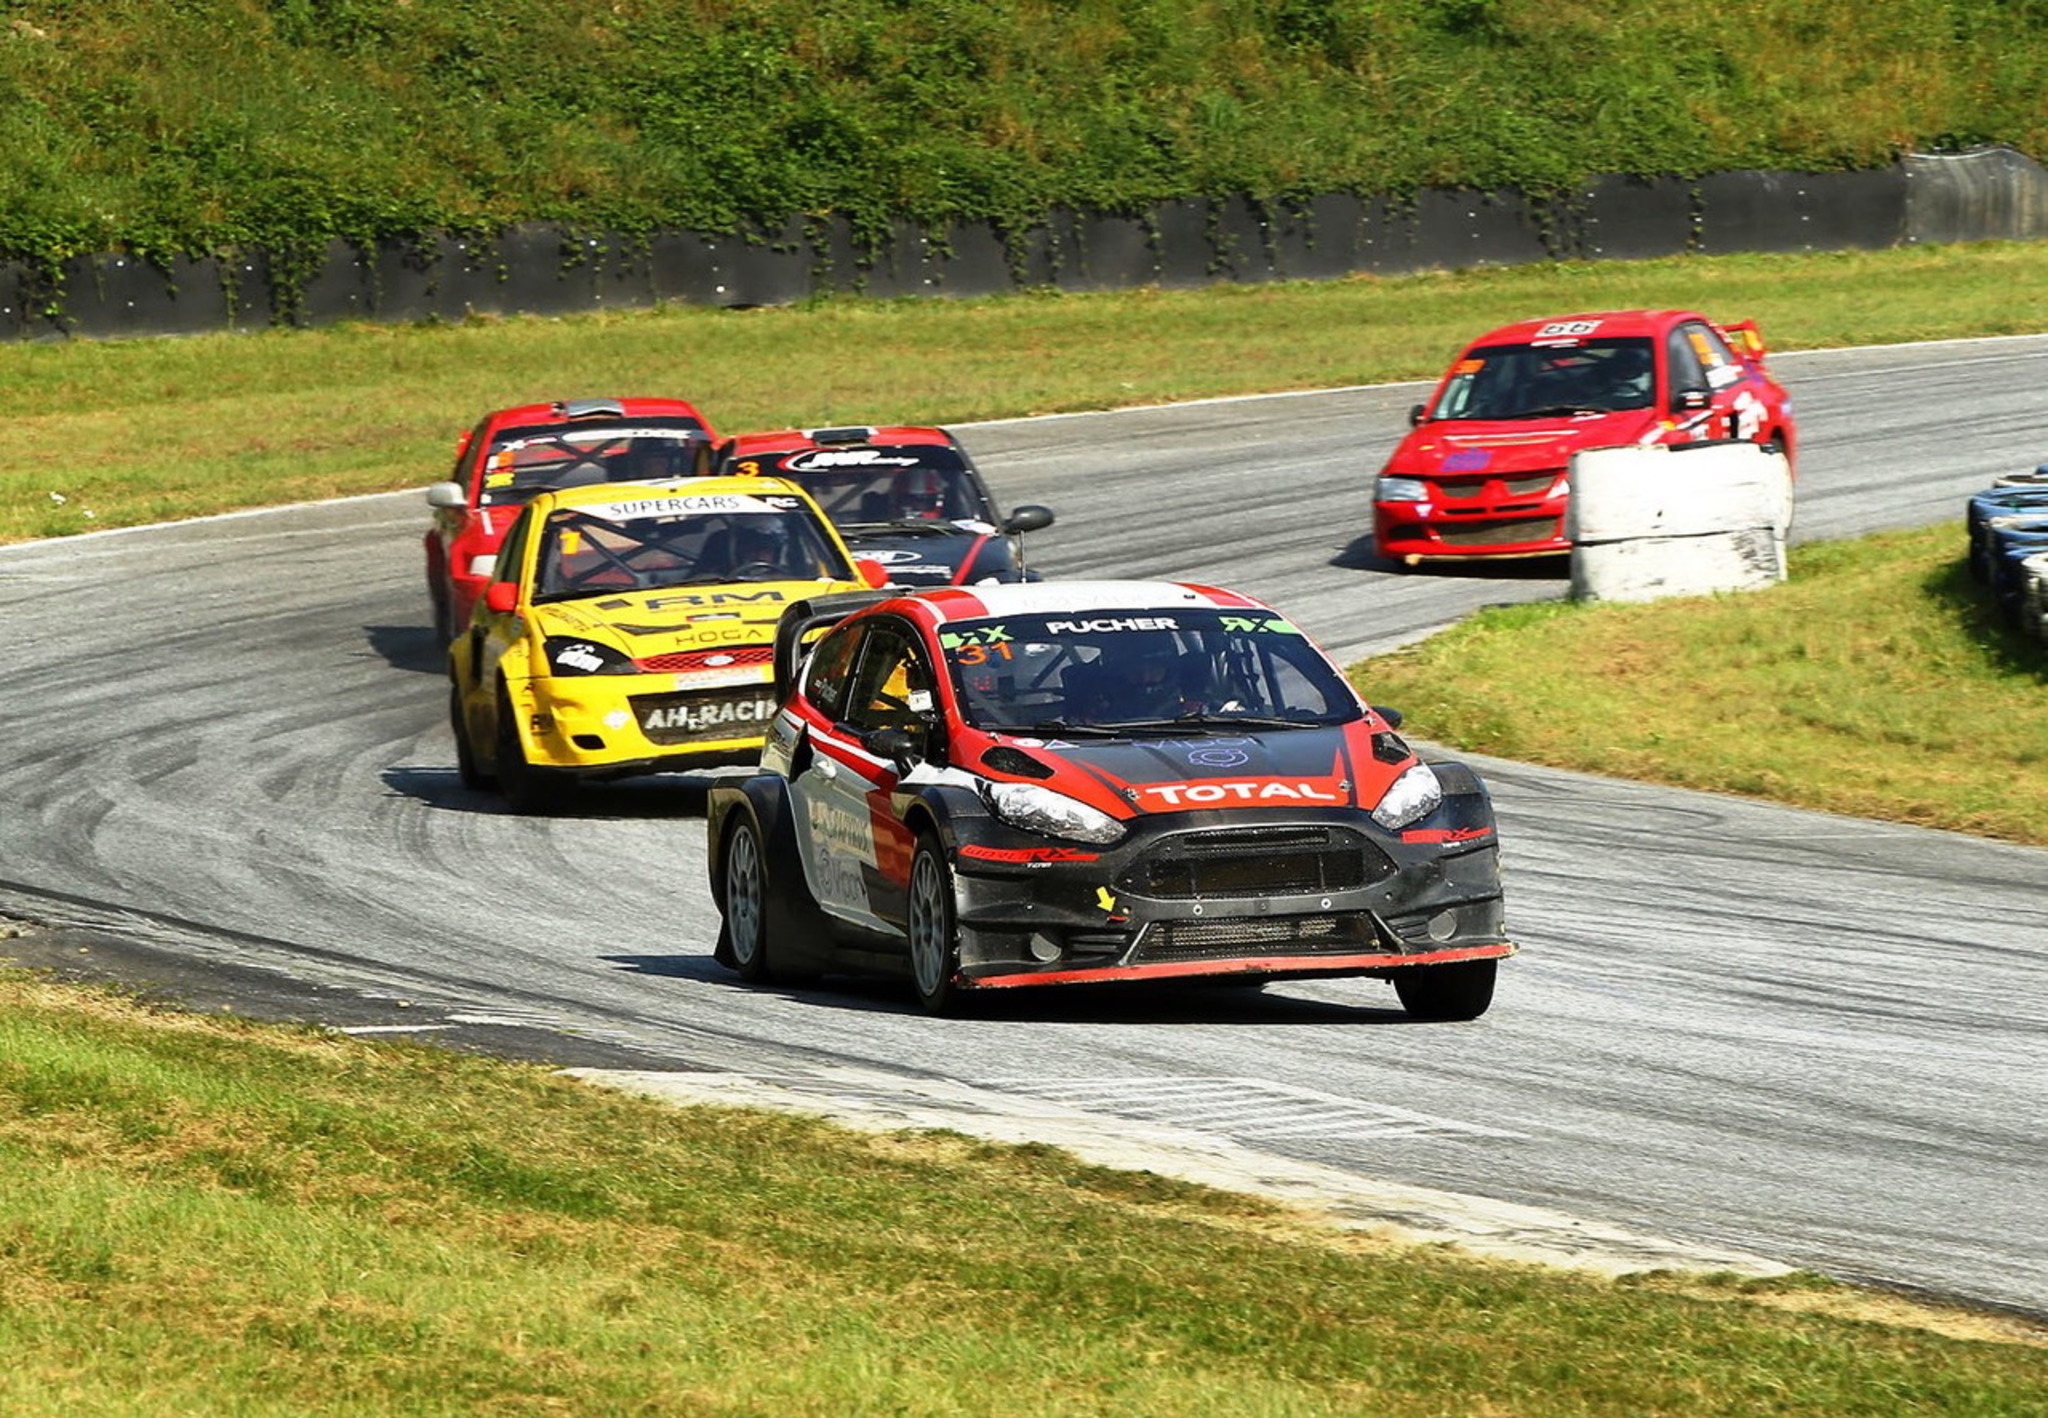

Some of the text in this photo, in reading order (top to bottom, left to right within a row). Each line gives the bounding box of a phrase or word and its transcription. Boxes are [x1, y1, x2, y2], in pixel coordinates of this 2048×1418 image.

[736, 461, 760, 477] 3
[610, 496, 740, 516] SUPERCARS
[560, 532, 581, 554] 1
[1046, 616, 1179, 635] PUCHER
[957, 641, 1014, 665] 31
[1146, 782, 1336, 804] TOTAL
